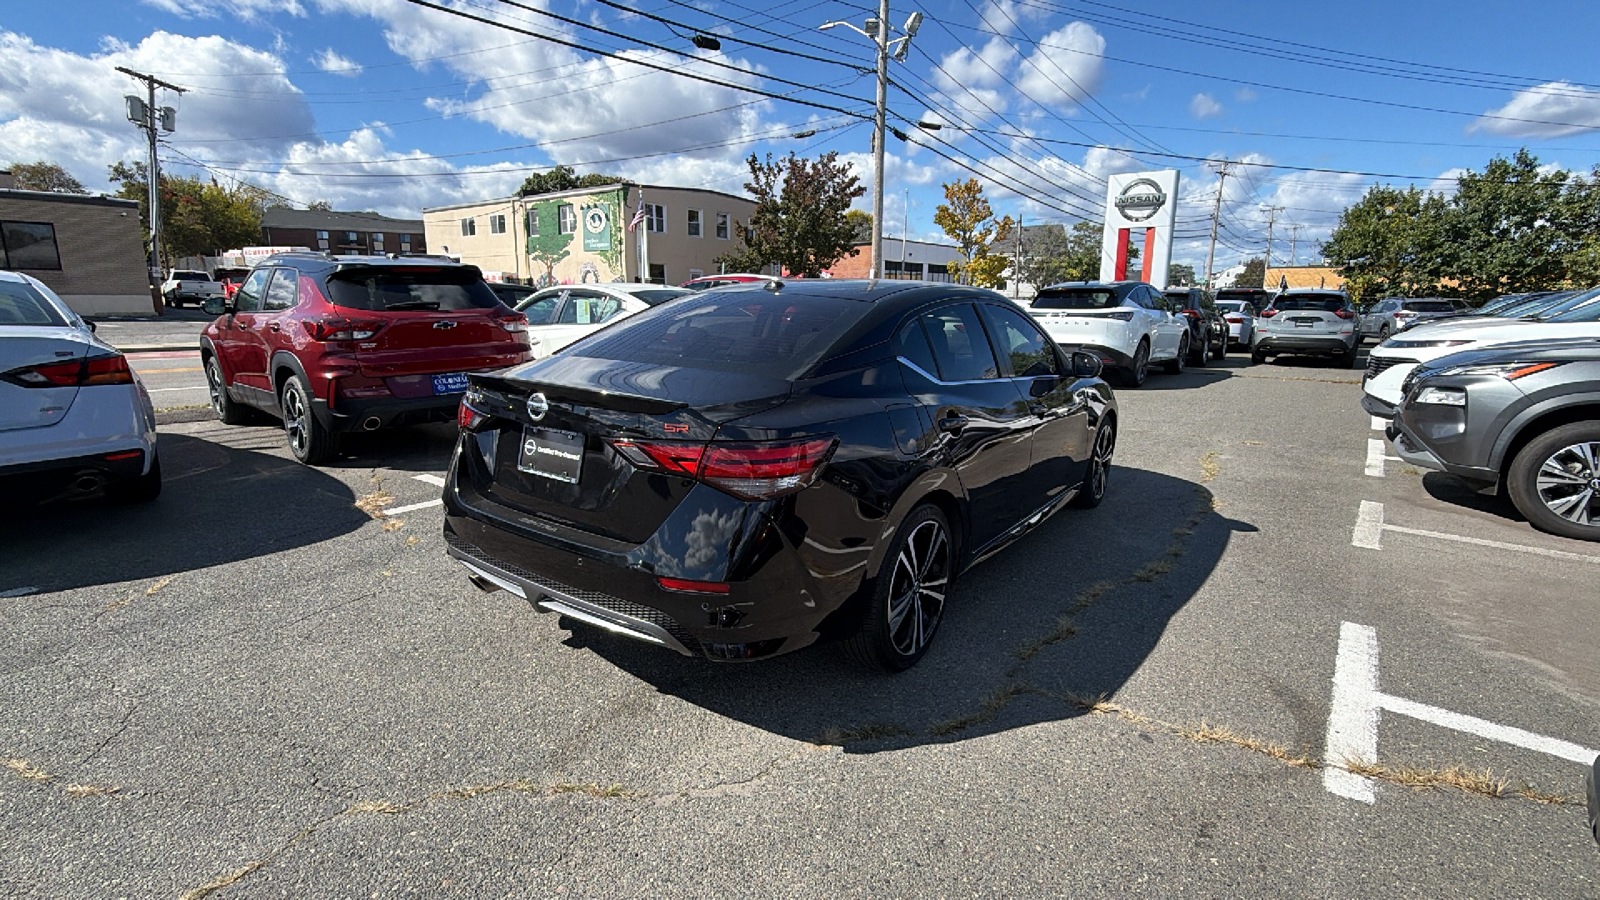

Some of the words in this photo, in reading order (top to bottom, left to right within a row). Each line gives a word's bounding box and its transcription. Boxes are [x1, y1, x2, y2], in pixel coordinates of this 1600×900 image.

[1118, 194, 1161, 204] NISSAN
[434, 376, 469, 385] COLONIAL
[664, 422, 690, 434] SR
